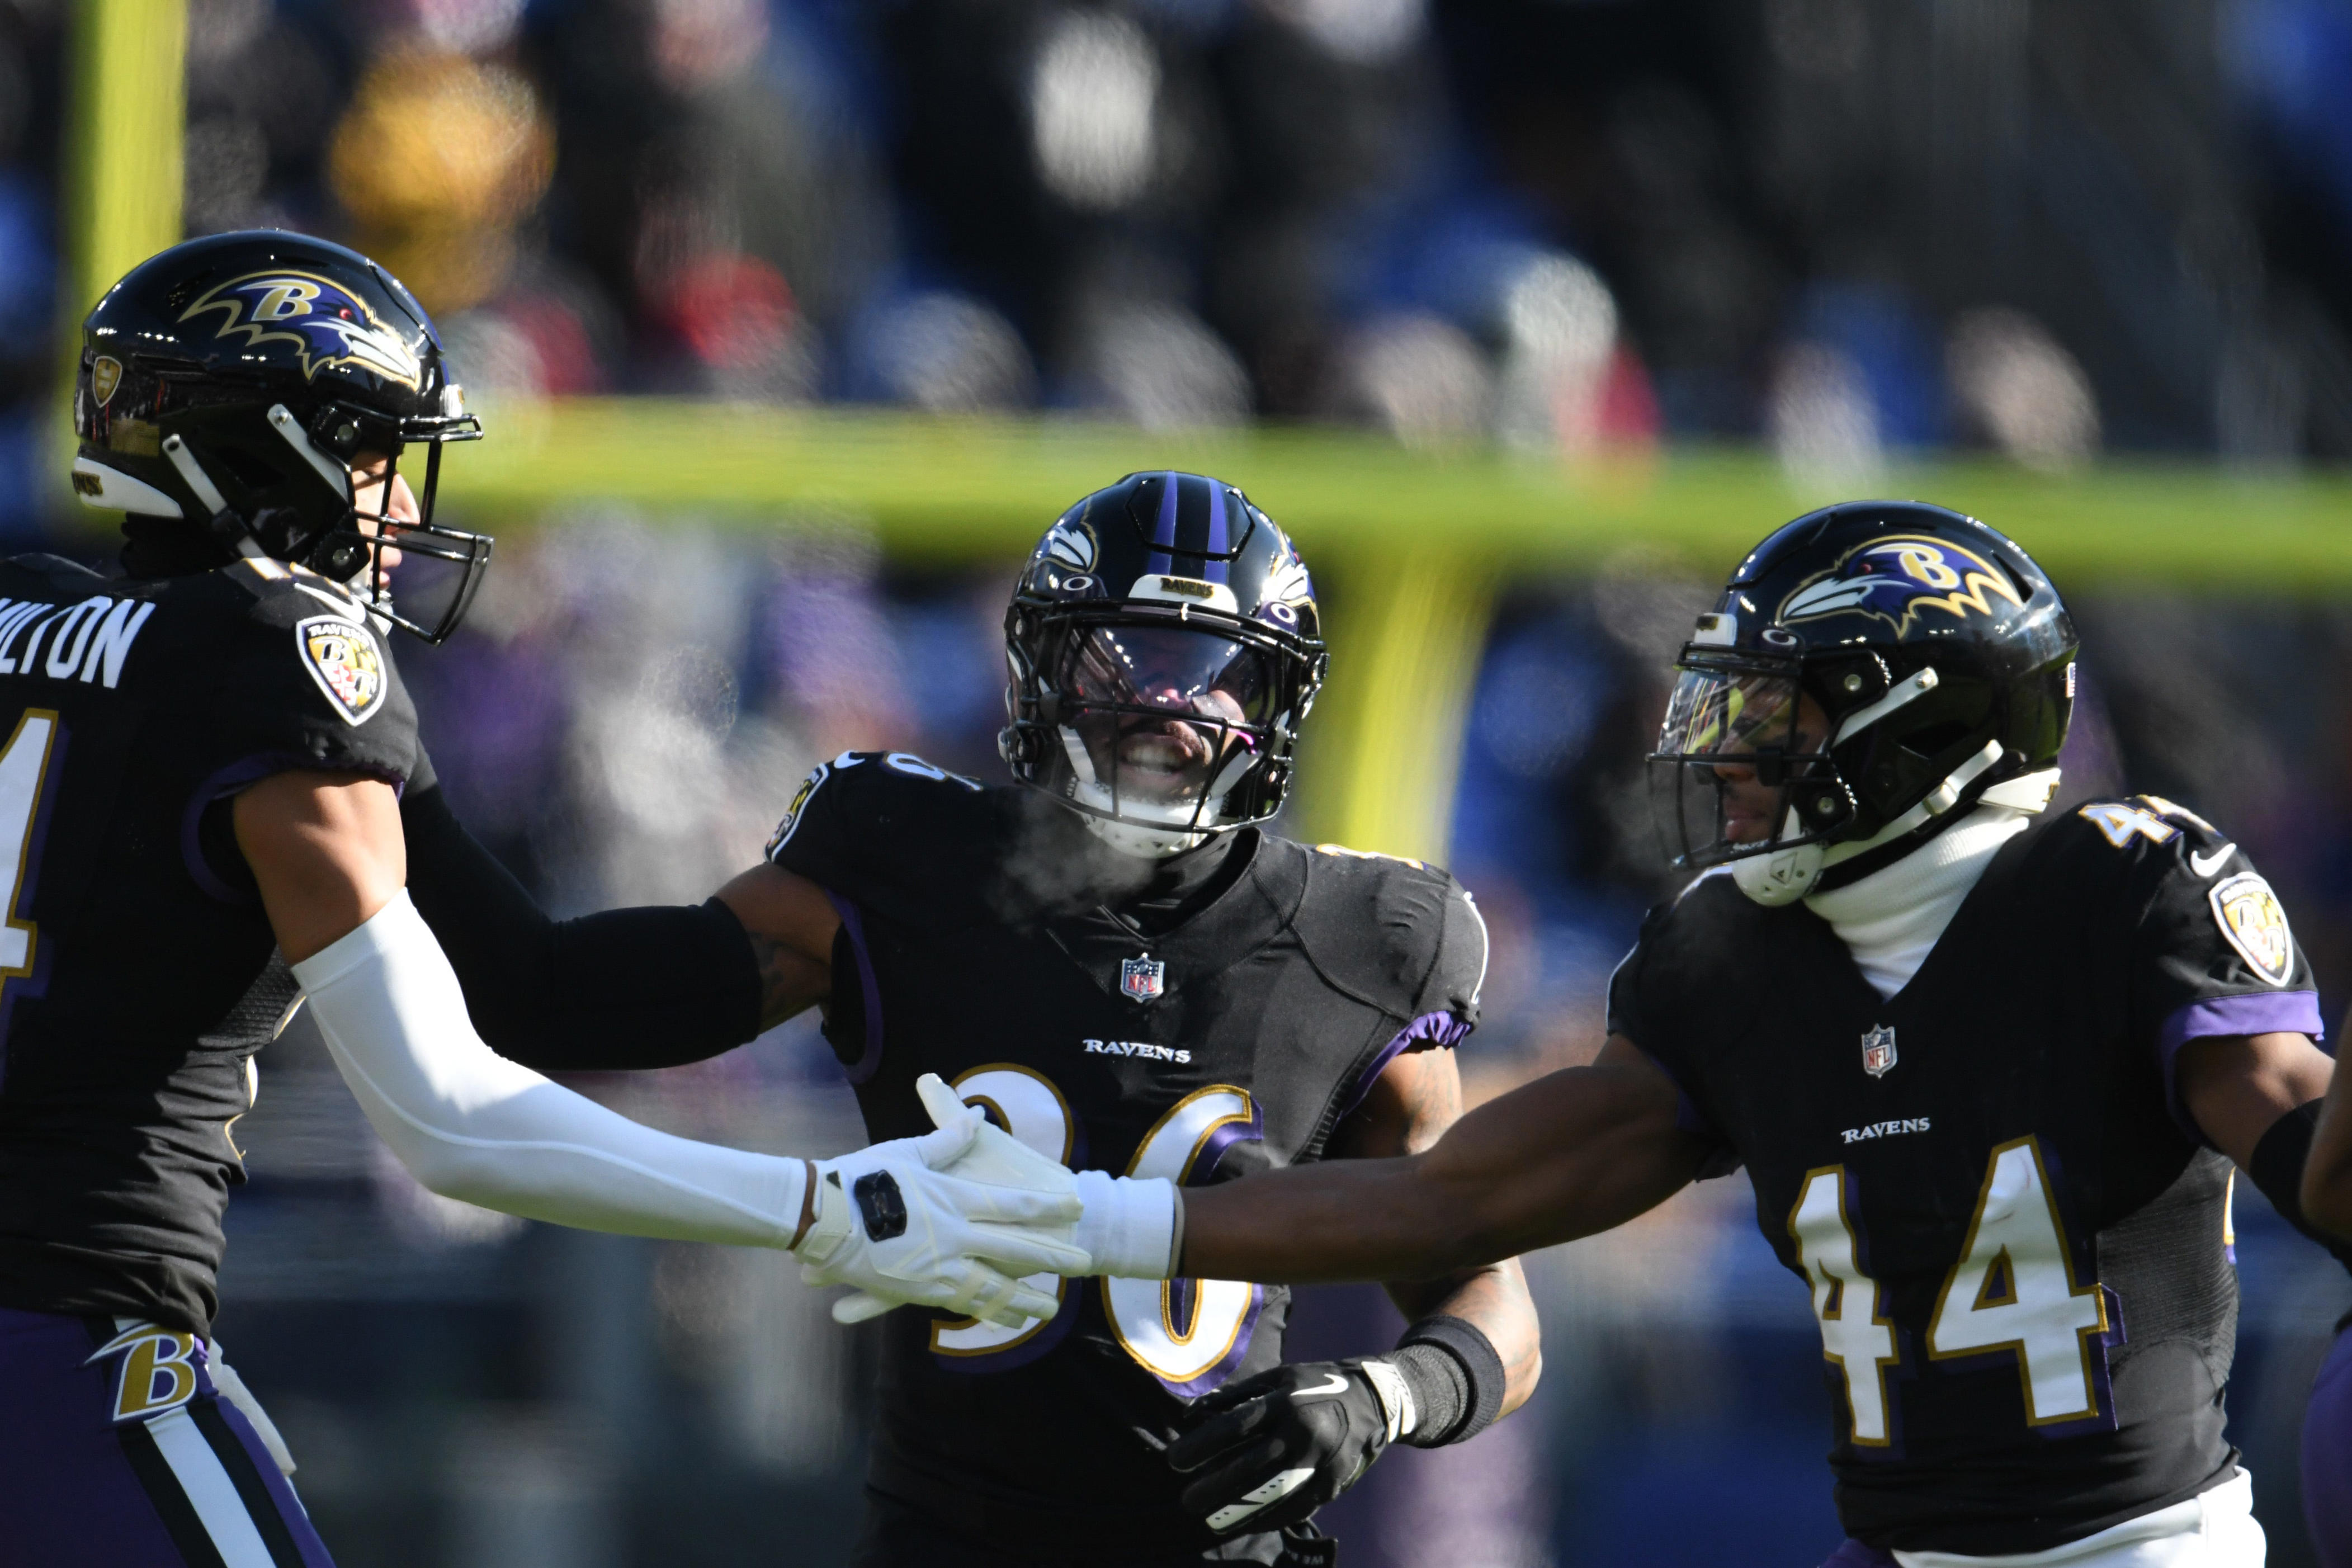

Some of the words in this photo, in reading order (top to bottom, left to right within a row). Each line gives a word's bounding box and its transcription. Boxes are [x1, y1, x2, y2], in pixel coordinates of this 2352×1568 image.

[236, 279, 321, 322] B
[1864, 542, 1961, 589] B
[1160, 577, 1214, 598] RAVENS
[1128, 975, 1156, 993] NFL
[1082, 1038, 1192, 1064] RAVENS
[1867, 1047, 1891, 1068] NFL
[1840, 1117, 1930, 1144] RAVENS
[1788, 1134, 2109, 1448] 44
[83, 1321, 197, 1423] B
